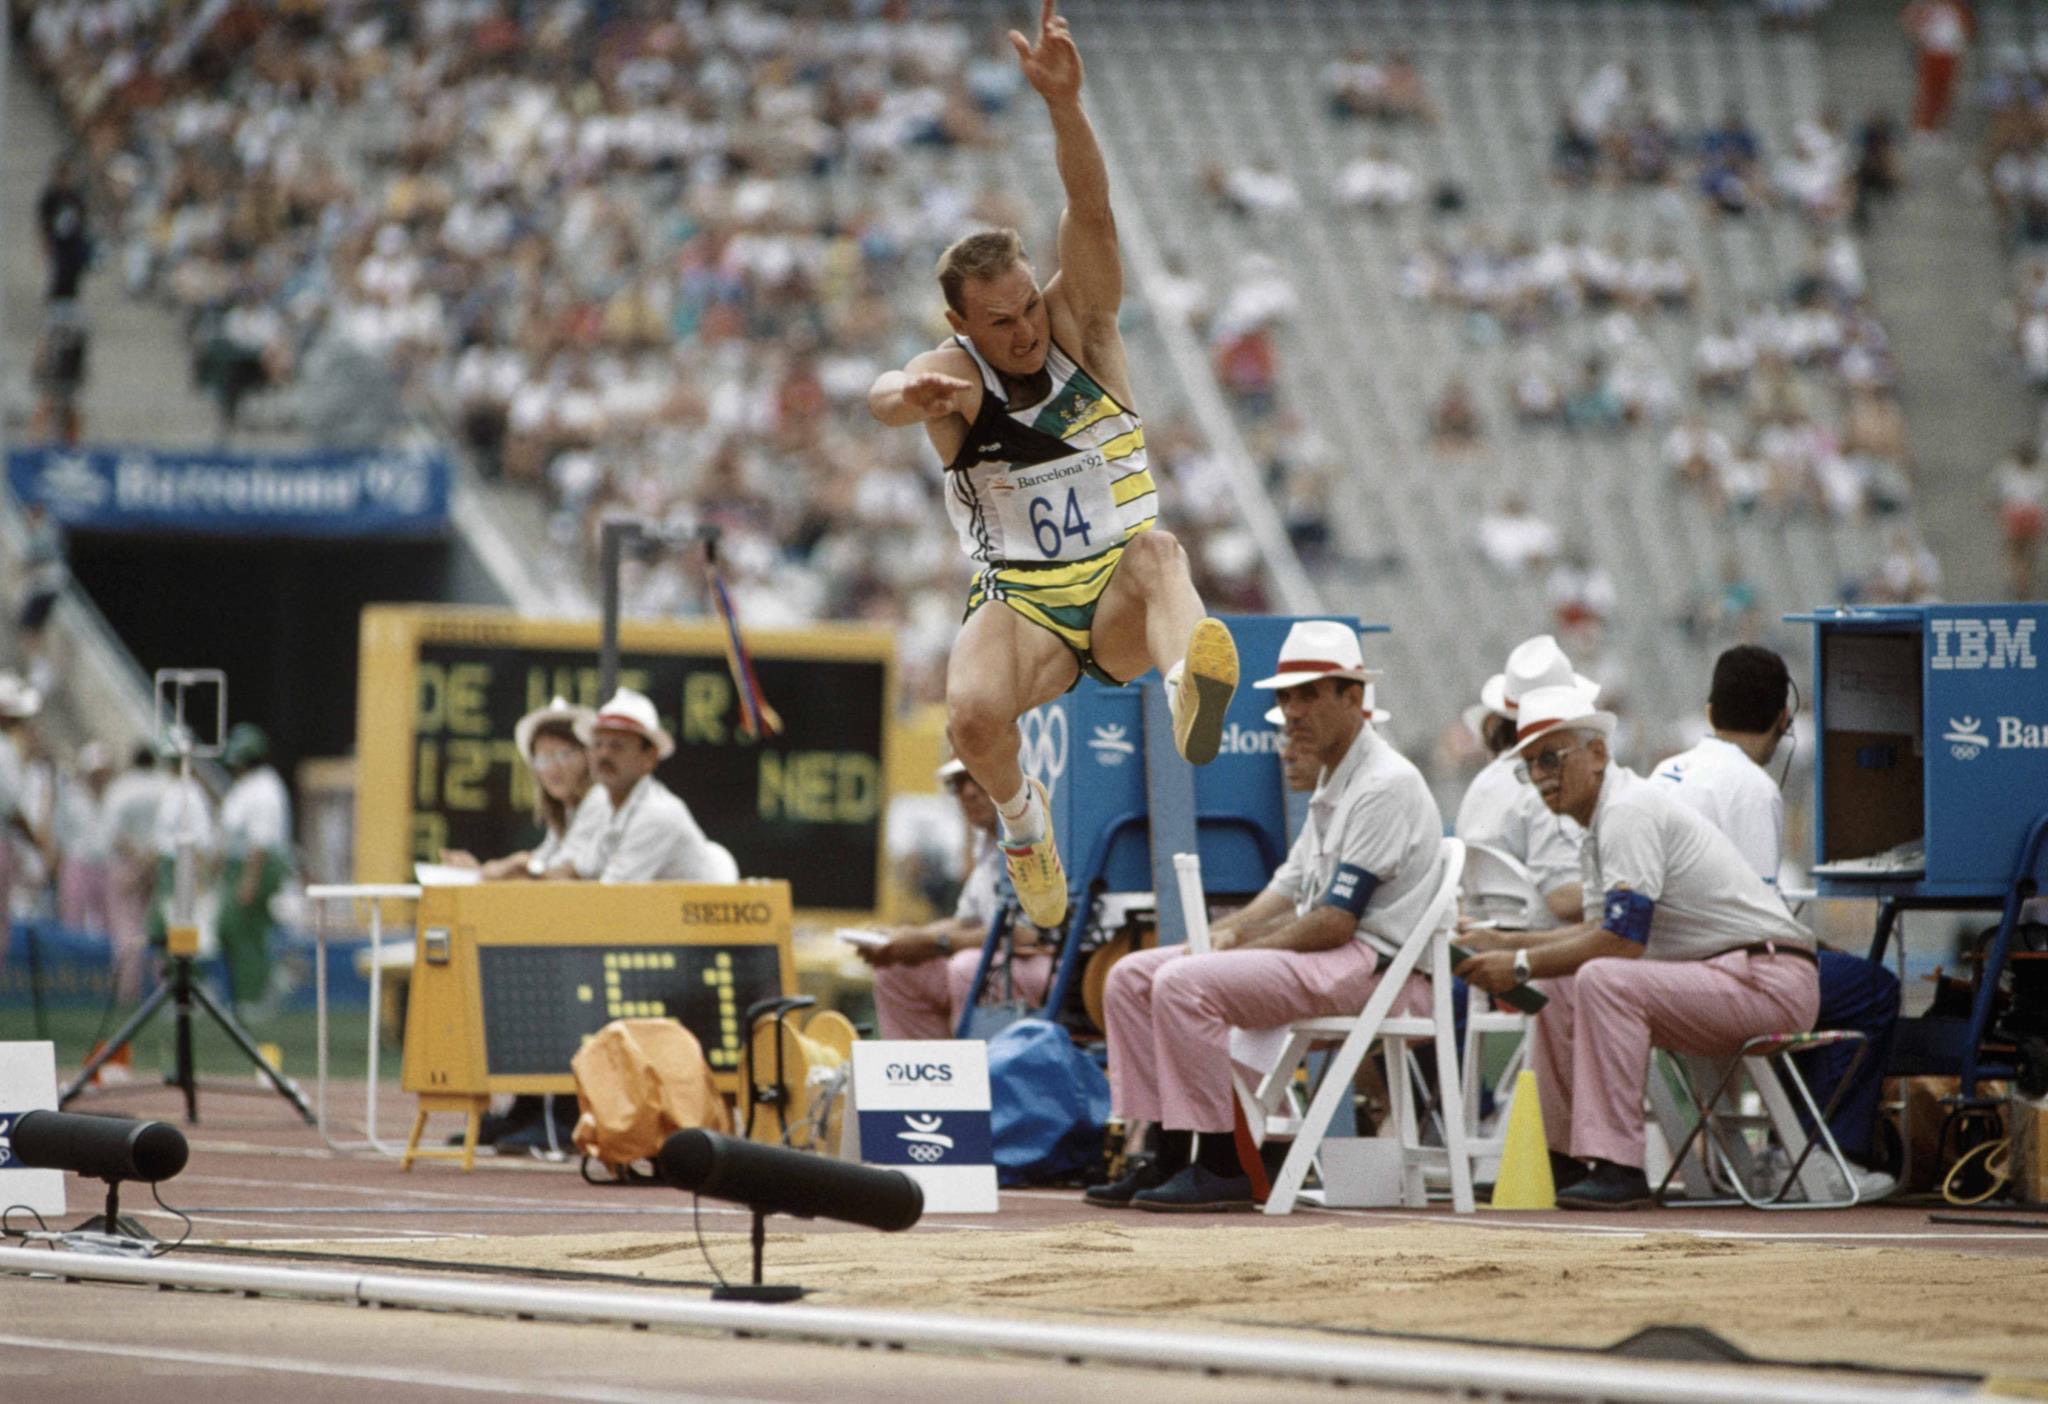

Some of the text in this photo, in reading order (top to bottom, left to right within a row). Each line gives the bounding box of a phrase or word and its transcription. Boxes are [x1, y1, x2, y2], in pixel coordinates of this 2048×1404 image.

[1016, 461, 1083, 489] Barcelona
[1029, 486, 1092, 558] 64
[1931, 618, 2037, 669] IBM
[415, 662, 492, 734] DE
[757, 751, 882, 823] NED
[682, 902, 772, 925] SEIKO
[905, 1063, 953, 1082] UCS
